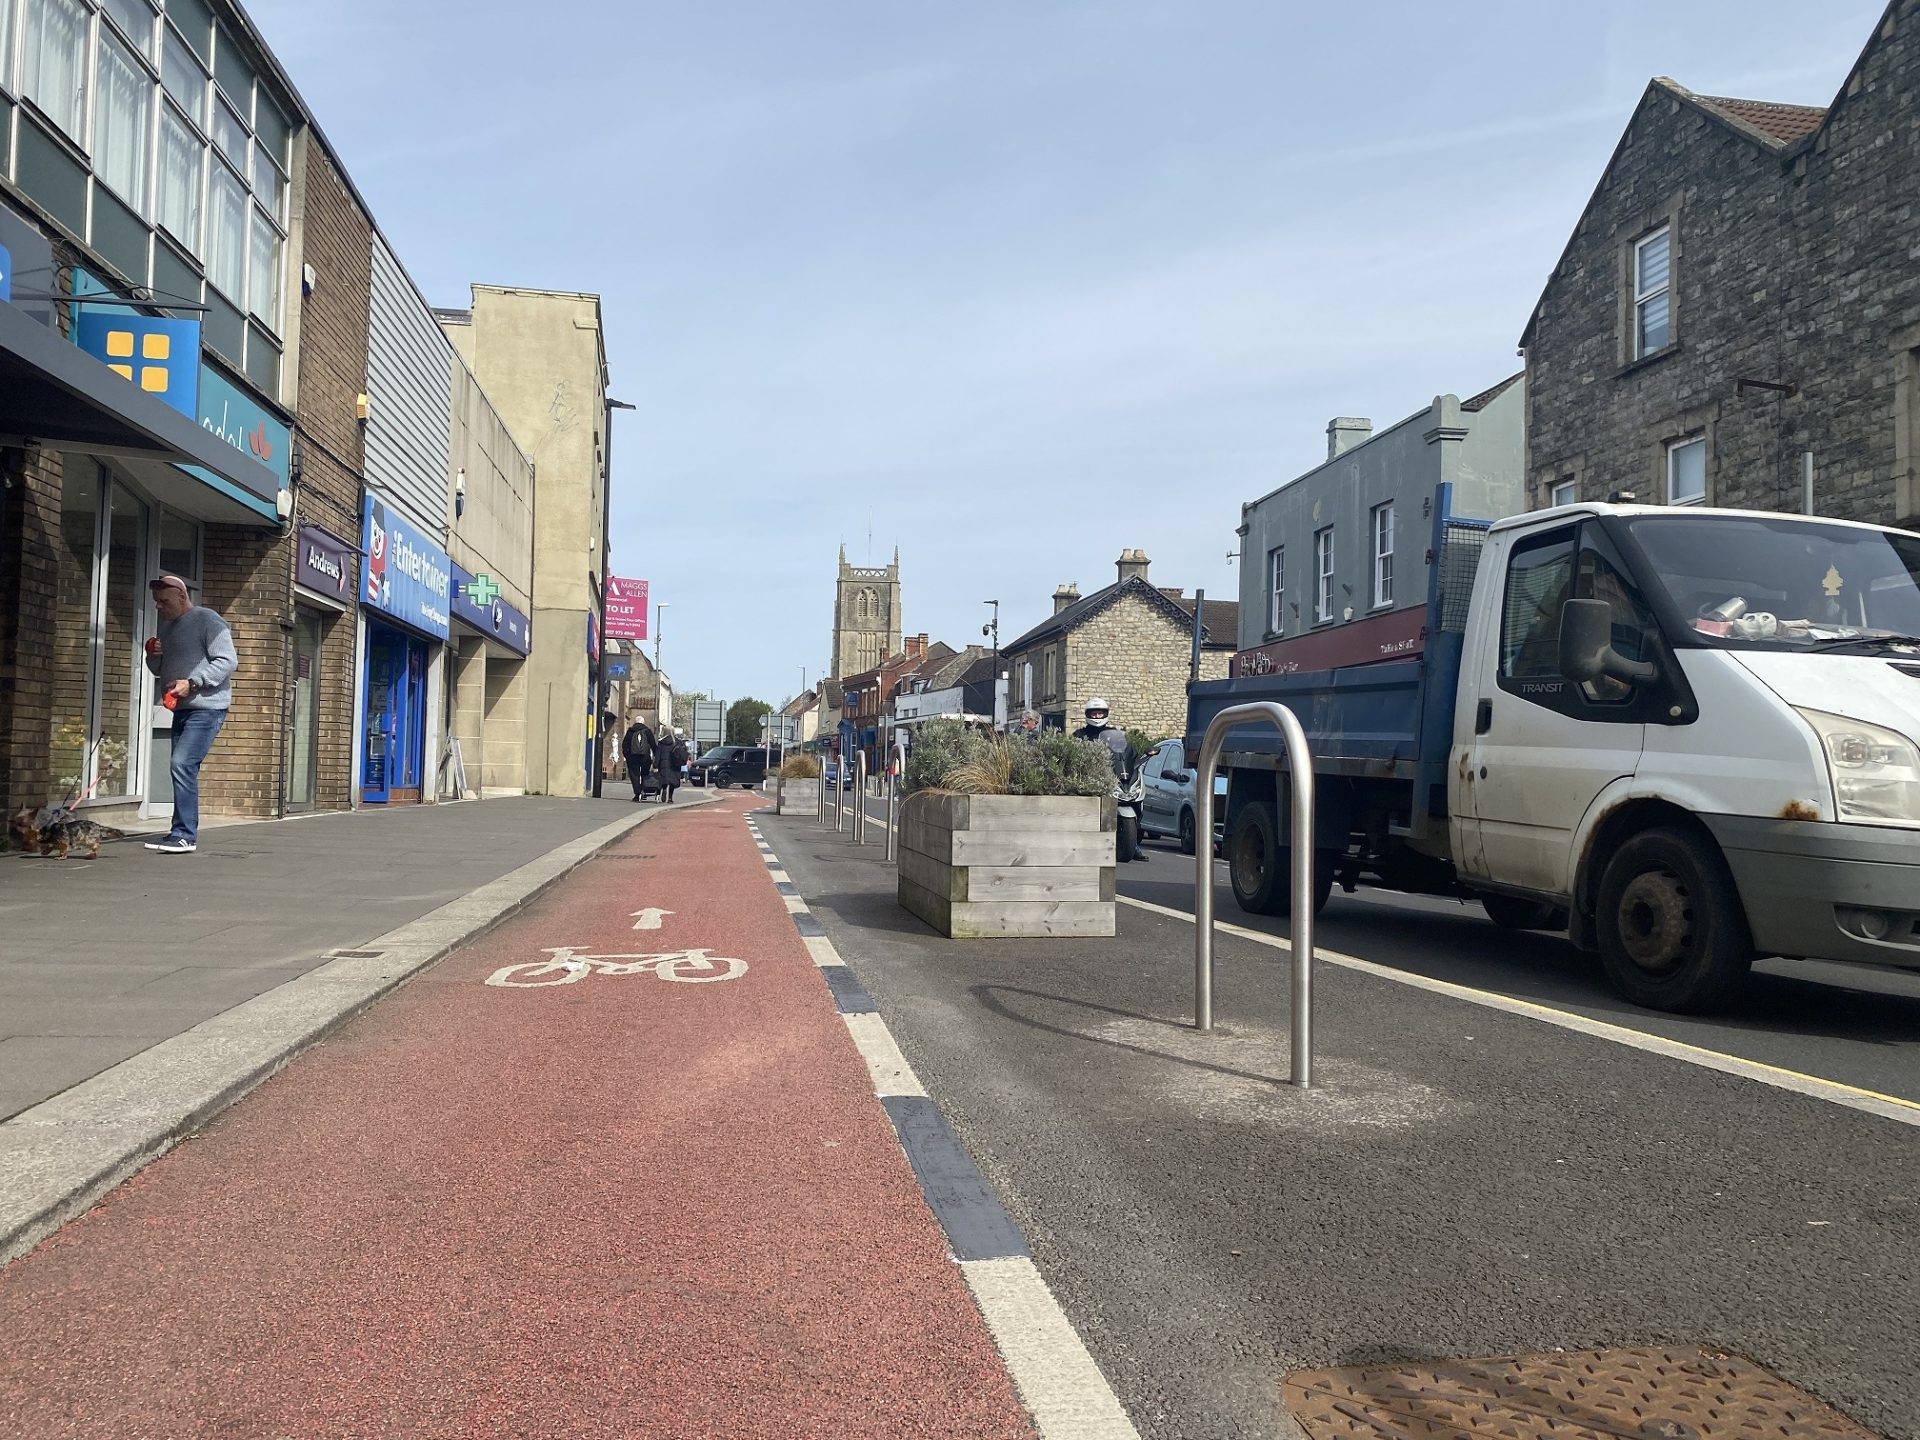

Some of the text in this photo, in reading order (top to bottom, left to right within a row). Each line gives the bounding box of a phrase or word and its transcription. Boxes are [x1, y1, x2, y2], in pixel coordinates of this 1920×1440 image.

[308, 545, 340, 580] Andrews
[396, 532, 449, 599] Entertainer
[621, 582, 648, 590] MAGGS
[606, 604, 635, 614] TO LET
[1522, 683, 1564, 692] TRANSIT
